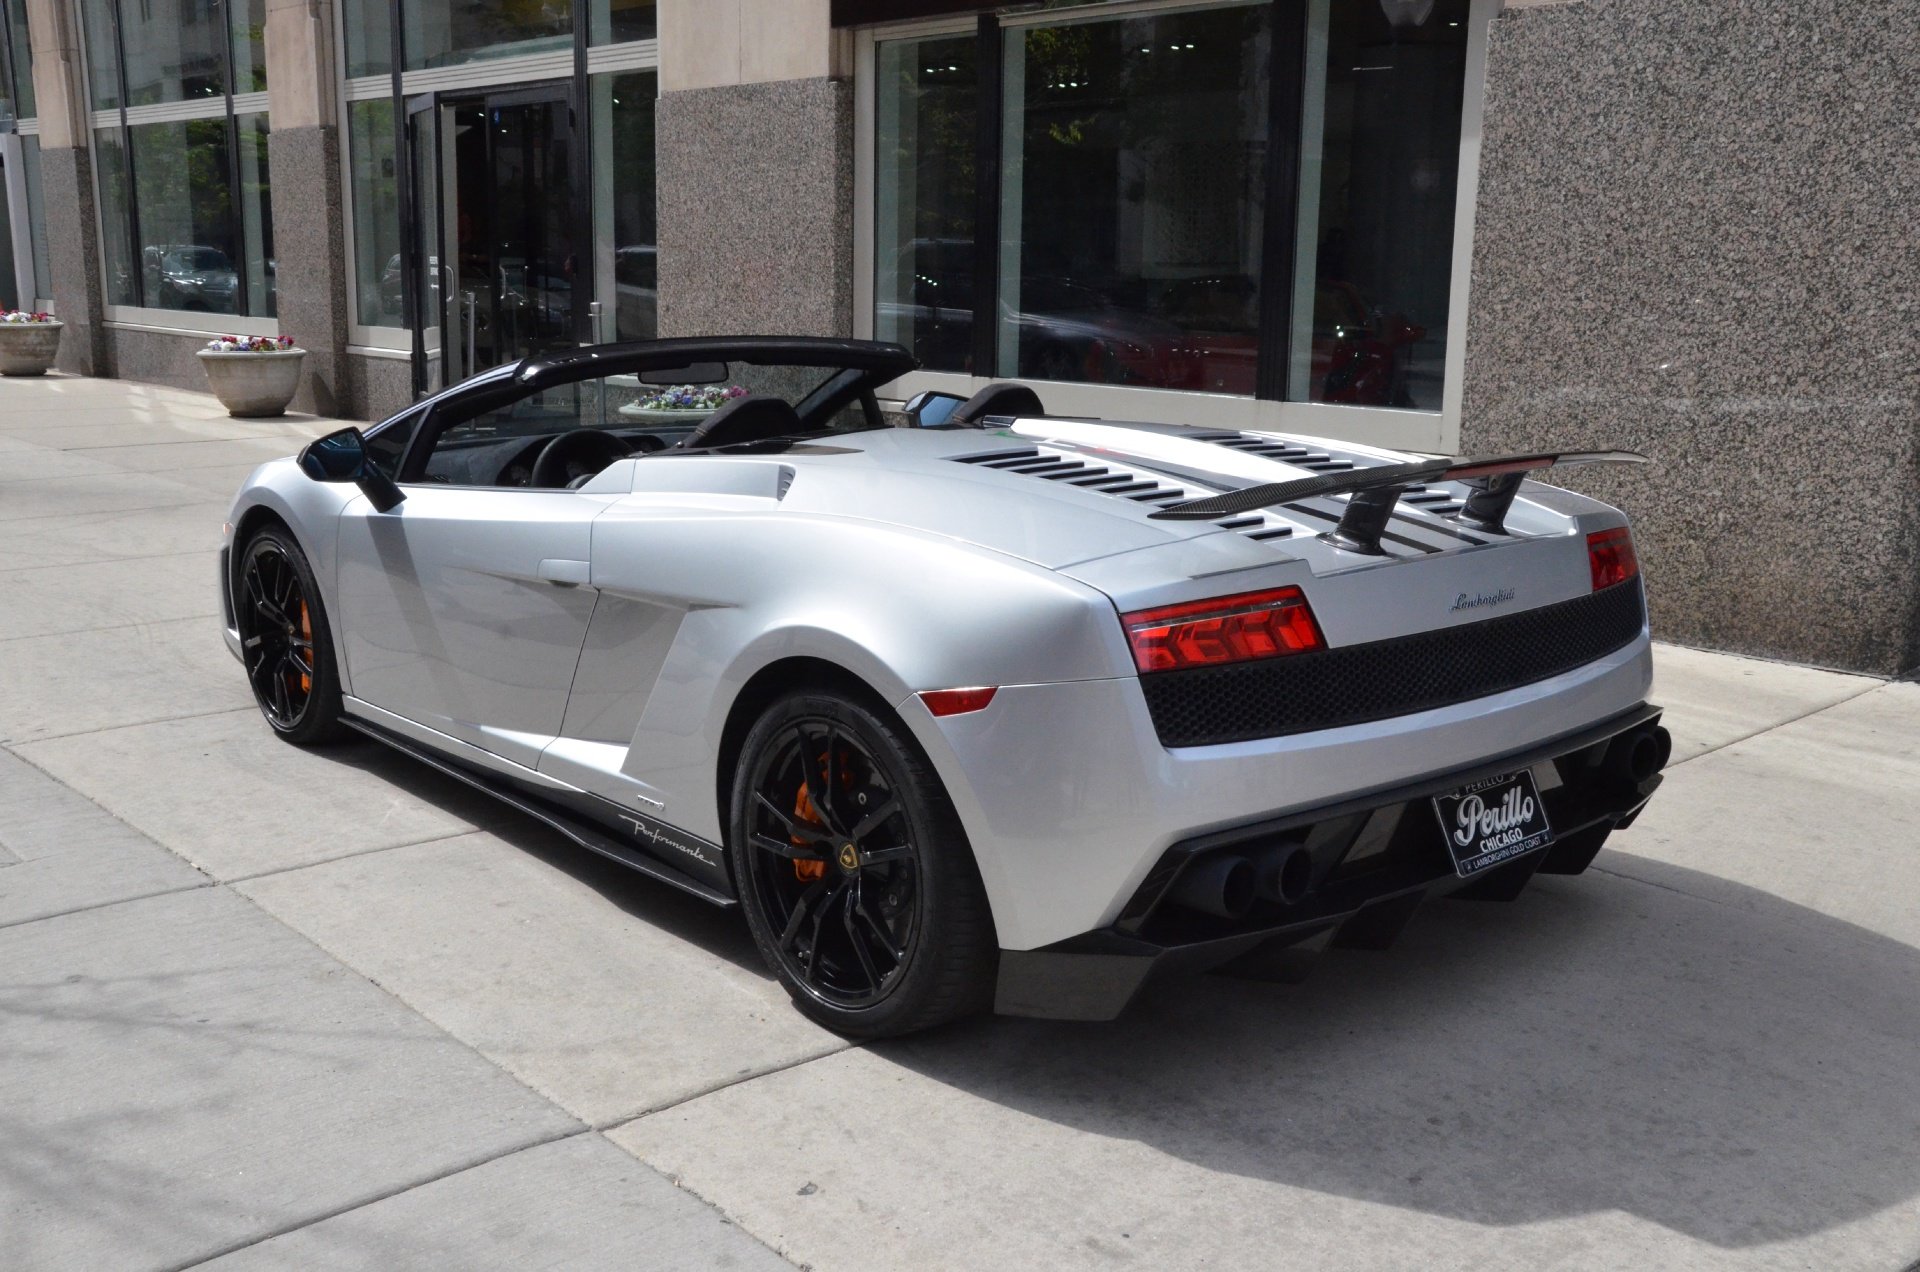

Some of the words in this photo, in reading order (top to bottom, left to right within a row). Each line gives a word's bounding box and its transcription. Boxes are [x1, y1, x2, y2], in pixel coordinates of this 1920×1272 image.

[1448, 587, 1515, 613] Lamborghini
[1454, 785, 1534, 846] Perillo
[618, 814, 717, 867] Performante
[1473, 849, 1510, 869] LAMBORGHINI
[1509, 843, 1525, 855] GOLD
[1524, 836, 1541, 849] COAST
[1480, 827, 1523, 853] CHICAGO
